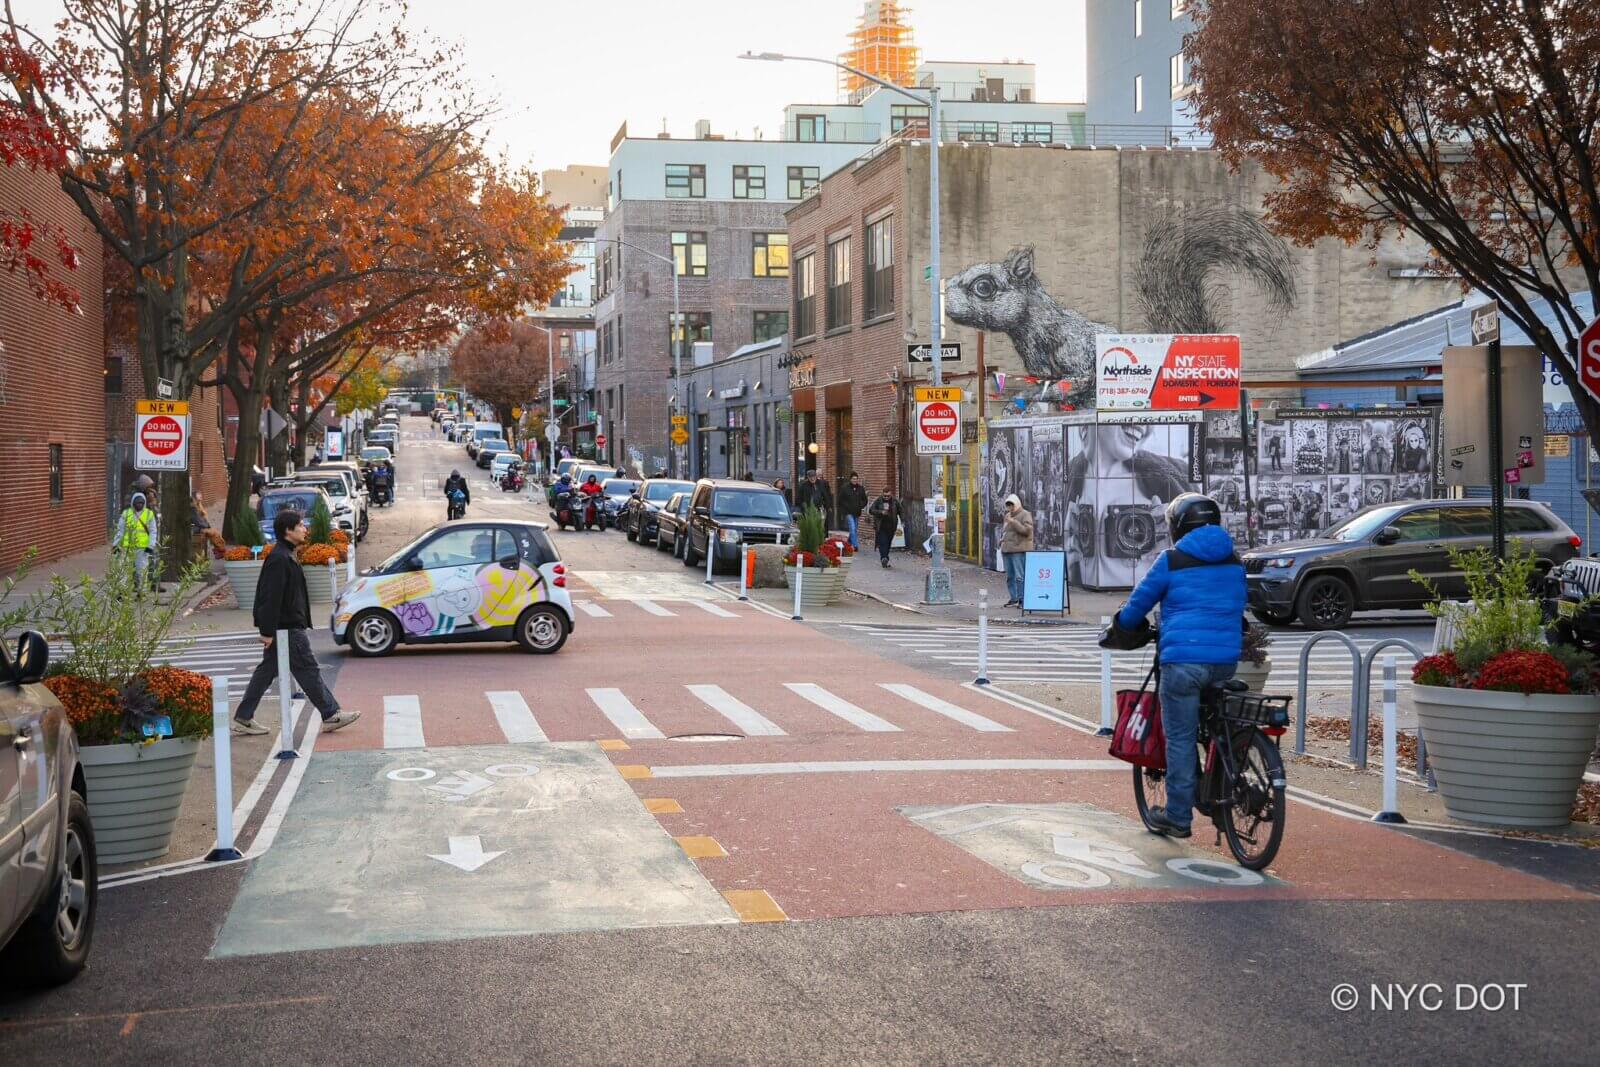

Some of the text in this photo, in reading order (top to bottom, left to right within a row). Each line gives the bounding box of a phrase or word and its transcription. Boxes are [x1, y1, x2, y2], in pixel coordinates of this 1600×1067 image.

[915, 349, 931, 358] ONE
[1174, 355, 1226, 368] NY STATE
[1103, 364, 1152, 377] Northside
[1162, 367, 1239, 379] INSPECTION
[1162, 379, 1239, 387] DOMESTIC FOREIGN
[926, 390, 950, 400] NEW
[150, 403, 175, 413] NEW
[925, 409, 953, 417] DO NOT
[147, 423, 177, 431] DO NOT
[147, 441, 175, 449] ENTER
[1038, 568, 1051, 579] $3
